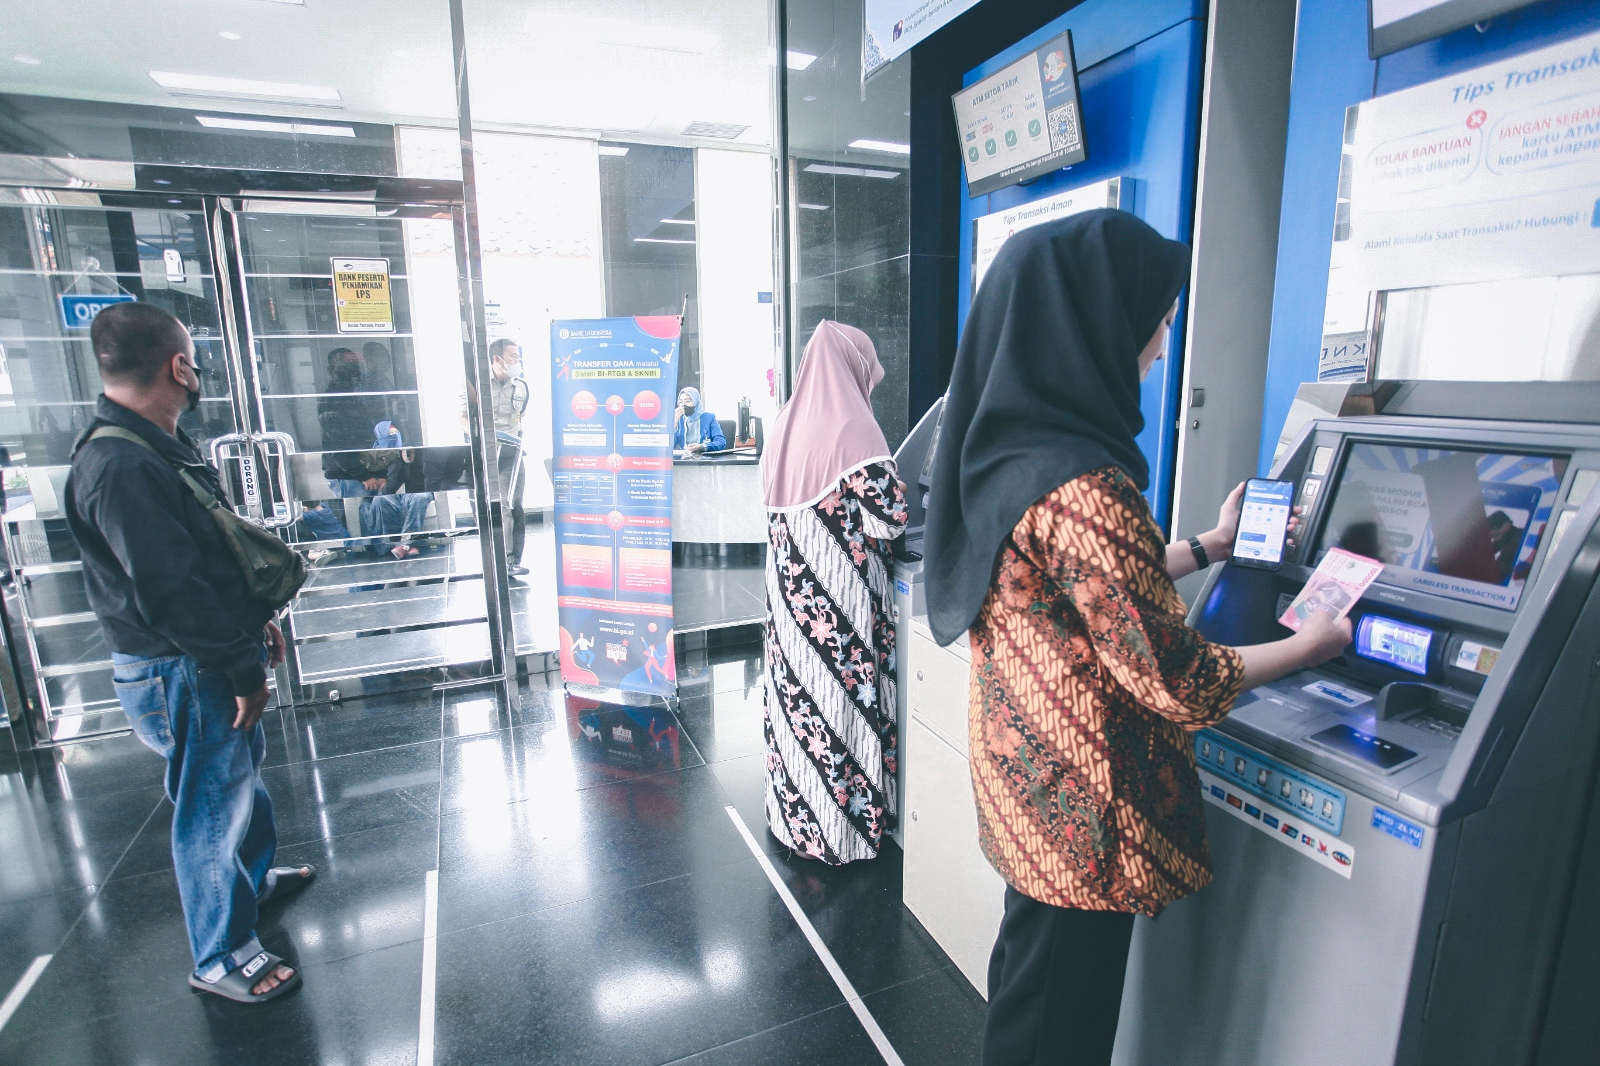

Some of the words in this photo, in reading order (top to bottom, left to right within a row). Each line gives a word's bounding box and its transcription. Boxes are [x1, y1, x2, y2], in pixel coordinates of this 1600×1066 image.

[972, 96, 983, 107] ATM
[984, 86, 1001, 100] SETOR
[1002, 77, 1019, 91] TARIK
[1453, 81, 1495, 103] Tips
[1498, 120, 1551, 140] JANGAN
[1522, 130, 1560, 148] kartu
[1375, 152, 1408, 167] TOLAK
[1412, 136, 1472, 158] BANTUAN
[1498, 148, 1548, 167] kepada
[1426, 153, 1471, 172] dikenal
[1004, 216, 1016, 225] Tips
[1018, 204, 1049, 220] Transaksi
[1050, 199, 1072, 211] Aman
[1365, 238, 1391, 249] Alami
[1393, 233, 1433, 246] Kendala
[1434, 230, 1459, 241] Saat
[1462, 221, 1521, 237] Transaksi?
[1524, 211, 1579, 228] Hubungi
[356, 290, 370, 299] LPS
[244, 459, 254, 495] DORONG
[1375, 496, 1405, 505] PALSU
[1387, 488, 1422, 497] MODUS
[1380, 591, 1406, 602] HITACHI
[1413, 577, 1448, 590] CARDLESS
[1451, 585, 1506, 602] TRANSACTION
[600, 627, 634, 635] www.bi.go.id
[1333, 853, 1350, 865] ALTO
